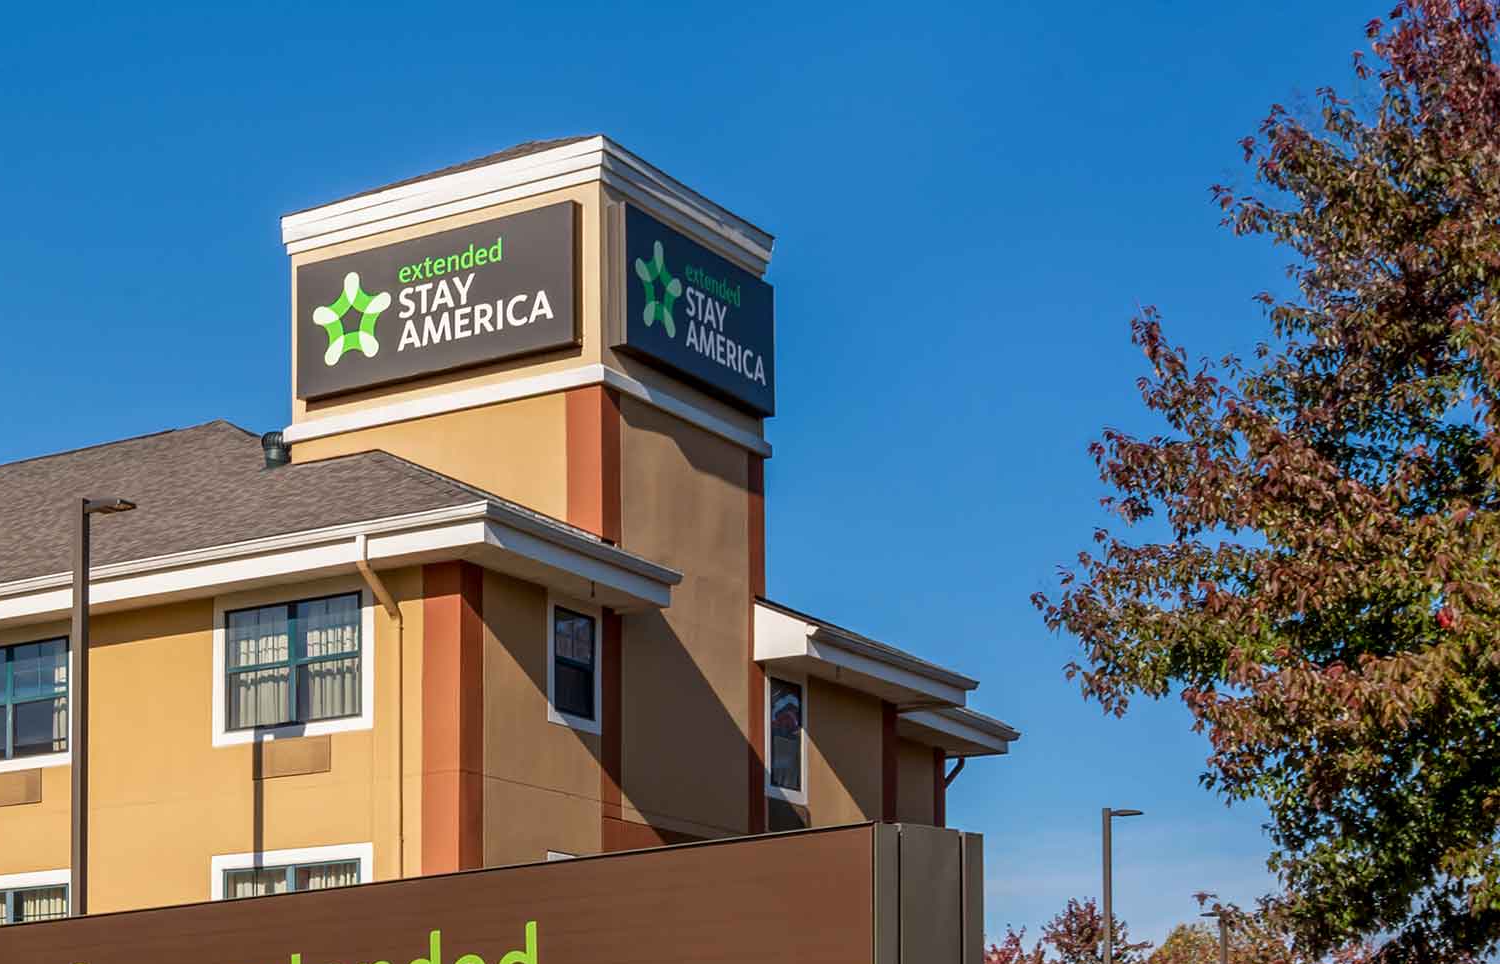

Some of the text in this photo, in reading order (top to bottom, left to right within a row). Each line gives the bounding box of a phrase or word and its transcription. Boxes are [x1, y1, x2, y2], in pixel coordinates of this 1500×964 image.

[398, 237, 503, 284] extended
[398, 272, 476, 319] STAY
[685, 264, 742, 307] extended
[685, 286, 727, 332] STAY
[397, 289, 555, 353] AMERICA
[685, 319, 767, 387] AMERICA
